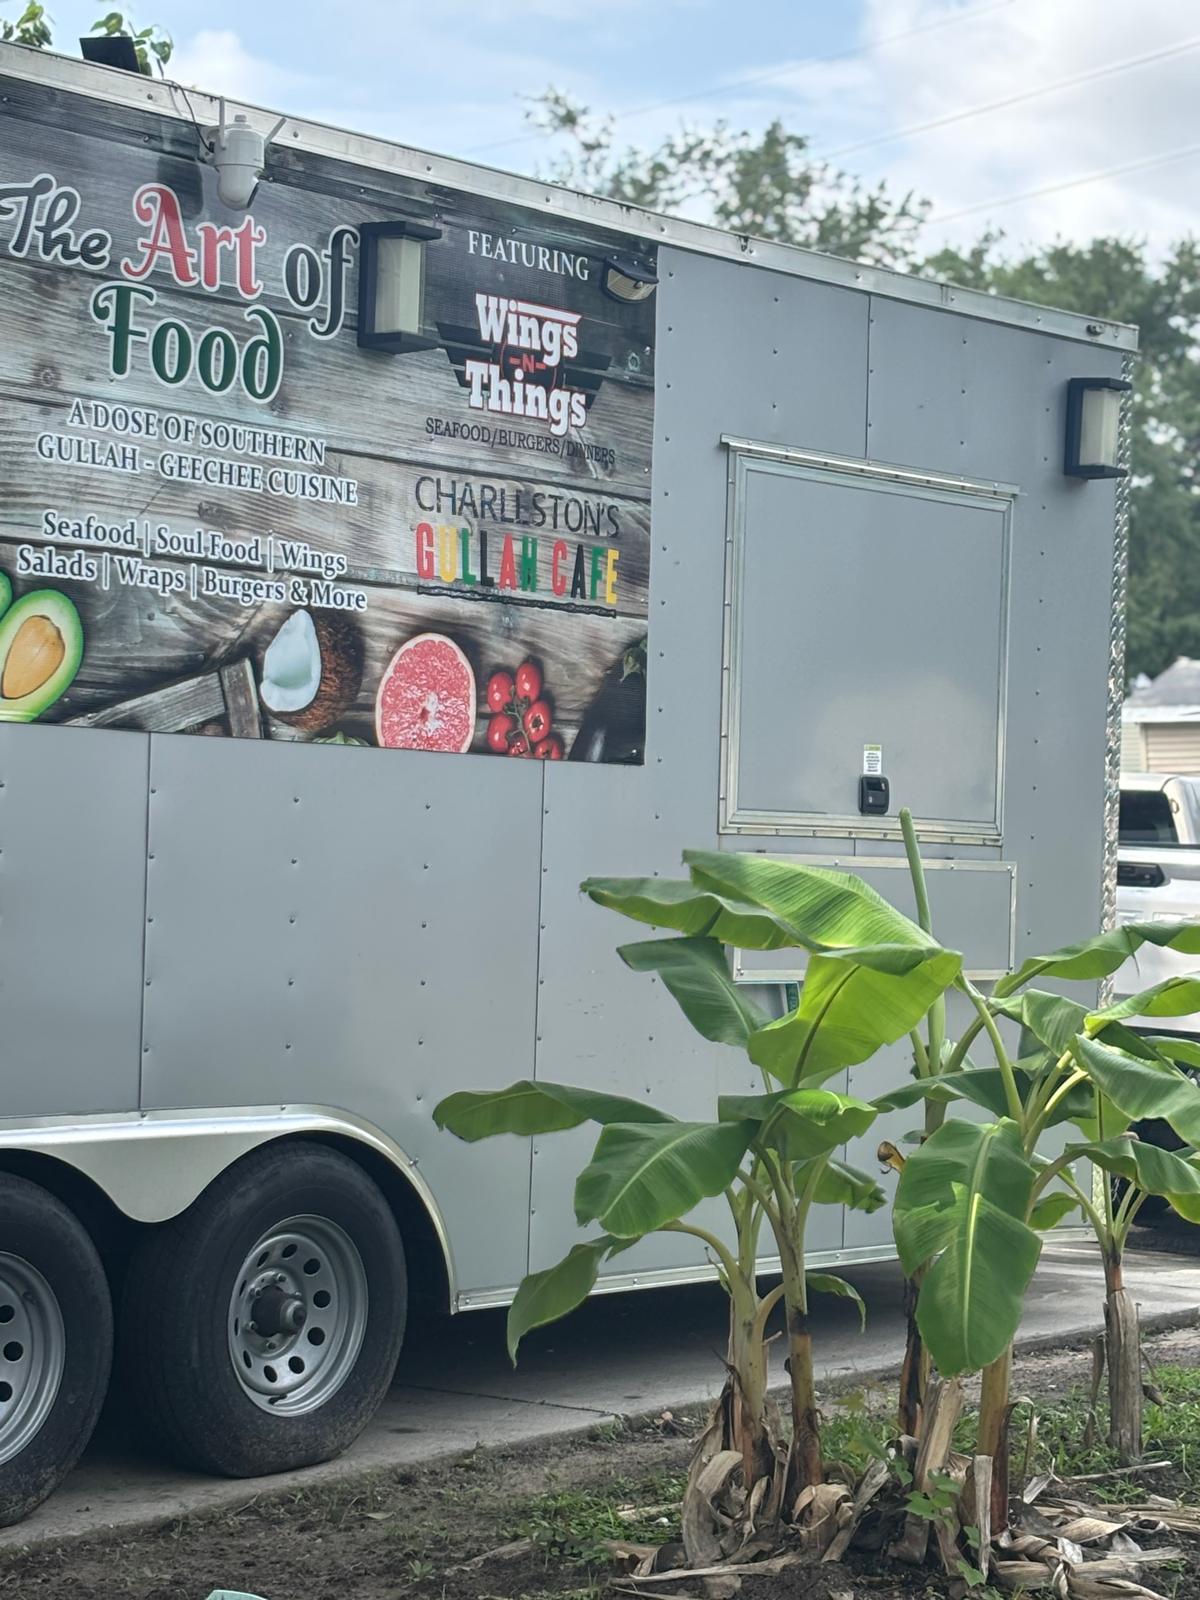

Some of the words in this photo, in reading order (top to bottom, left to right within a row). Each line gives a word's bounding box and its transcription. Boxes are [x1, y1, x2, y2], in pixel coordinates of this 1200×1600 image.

[0, 173, 111, 269] The
[121, 183, 266, 299] Art
[283, 225, 360, 340] of
[468, 230, 590, 281] FEATURING
[90, 281, 284, 404] Food
[475, 293, 582, 367] Wings
[68, 398, 87, 426] A
[91, 402, 158, 438] DOSE
[163, 415, 197, 444] OF
[200, 422, 327, 466] SOUTHERN
[465, 359, 587, 437] Things
[37, 434, 140, 474] GULLAH
[159, 452, 265, 490] GEECHEE
[267, 470, 358, 505] CUISINE
[16, 546, 98, 580] Salads
[114, 555, 186, 596] Wraps
[203, 570, 286, 606] Burgers
[289, 580, 310, 605] &
[312, 582, 369, 611] More
[43, 509, 138, 547] Seafood
[156, 525, 205, 556] Soul
[209, 530, 263, 564] Food
[279, 540, 348, 579] Wings
[416, 522, 538, 592] GULLAH
[552, 539, 620, 604] CAFE
